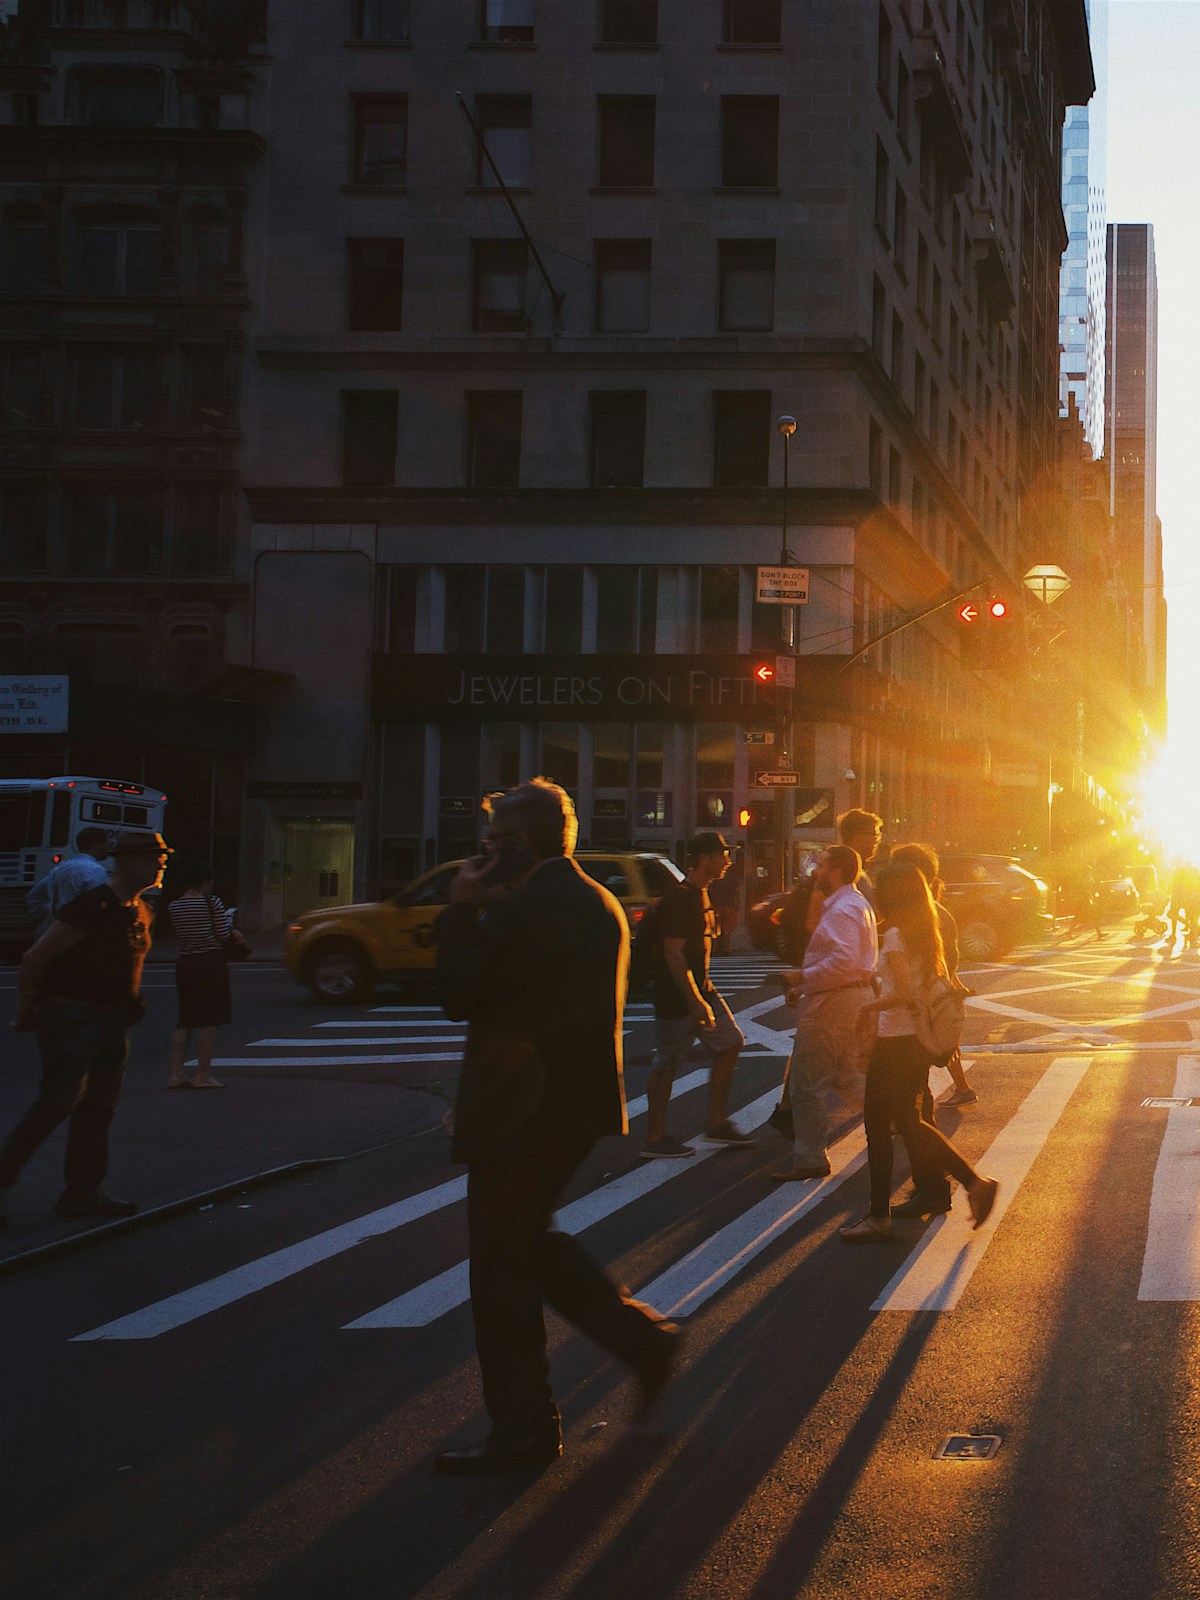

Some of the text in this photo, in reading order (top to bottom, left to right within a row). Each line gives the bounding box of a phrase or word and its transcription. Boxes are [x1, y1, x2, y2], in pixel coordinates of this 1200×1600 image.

[12, 683, 49, 698] Gallery
[52, 683, 62, 694] of
[447, 671, 603, 705] JEWELERS
[617, 676, 671, 705] ON
[746, 733, 753, 743] 5
